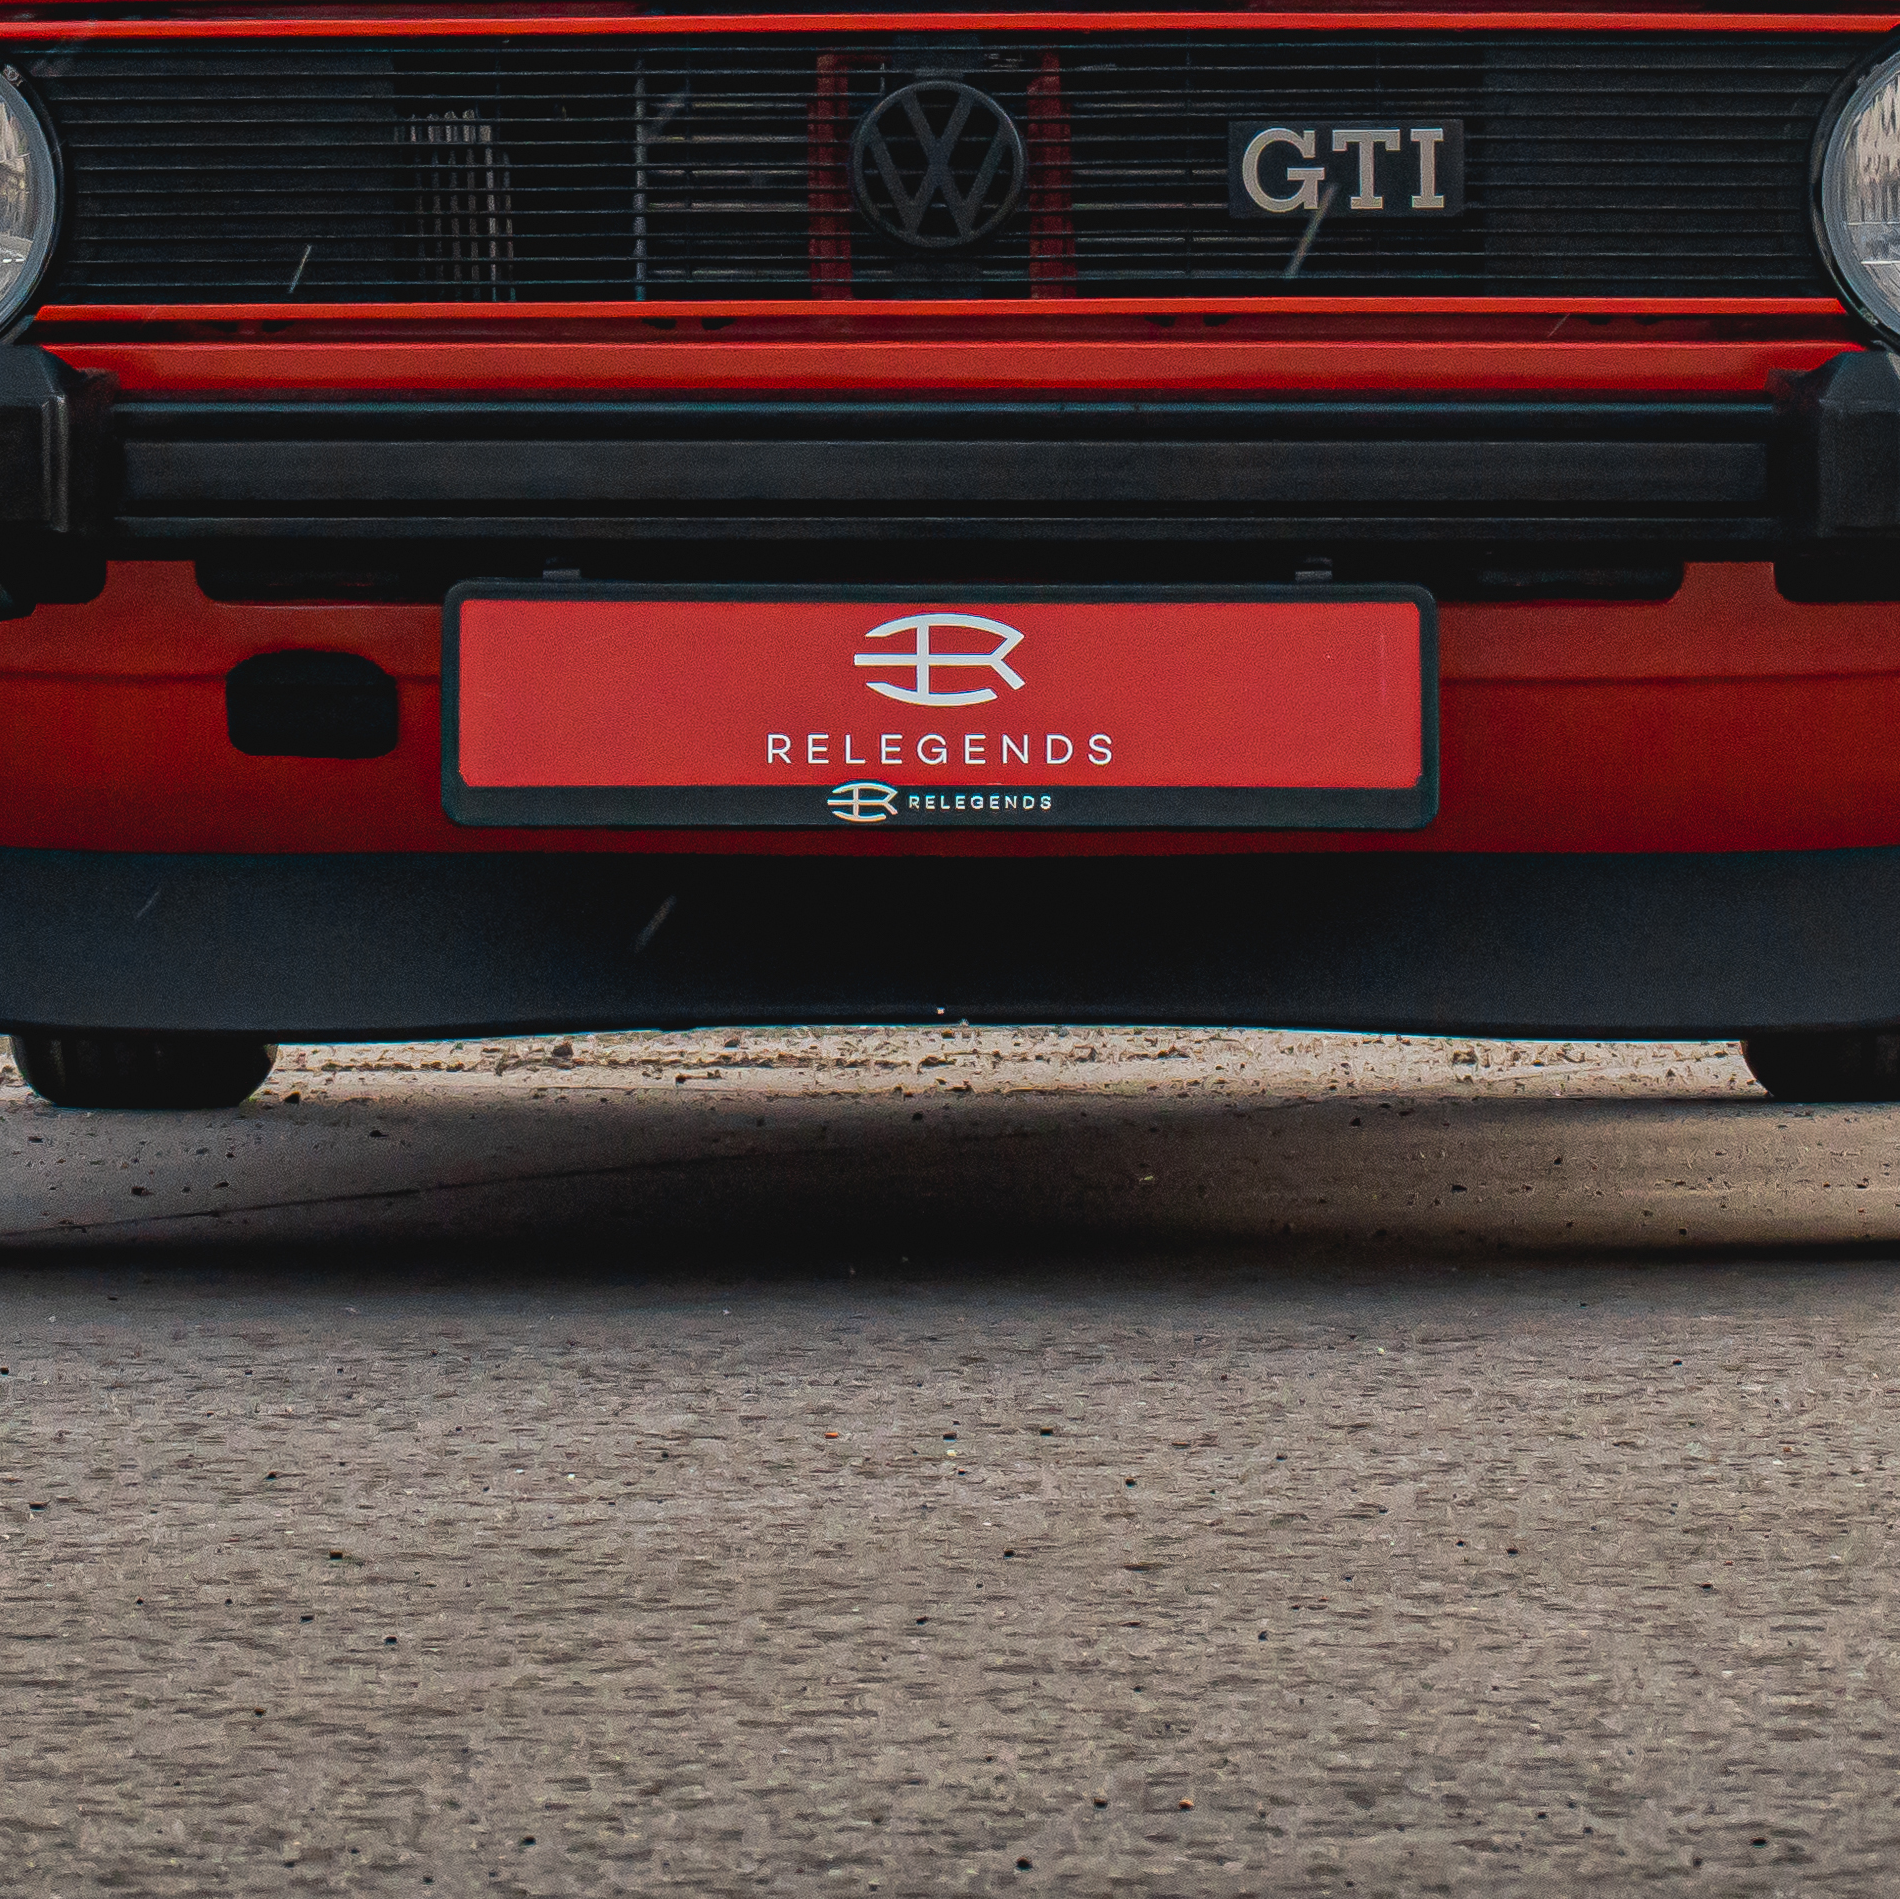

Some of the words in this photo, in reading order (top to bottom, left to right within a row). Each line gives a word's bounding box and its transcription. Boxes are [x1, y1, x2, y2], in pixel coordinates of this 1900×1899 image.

[1242, 127, 1445, 213] GTI
[766, 732, 1113, 766] RELEGENDS
[907, 794, 1053, 811] RELEGENDS
